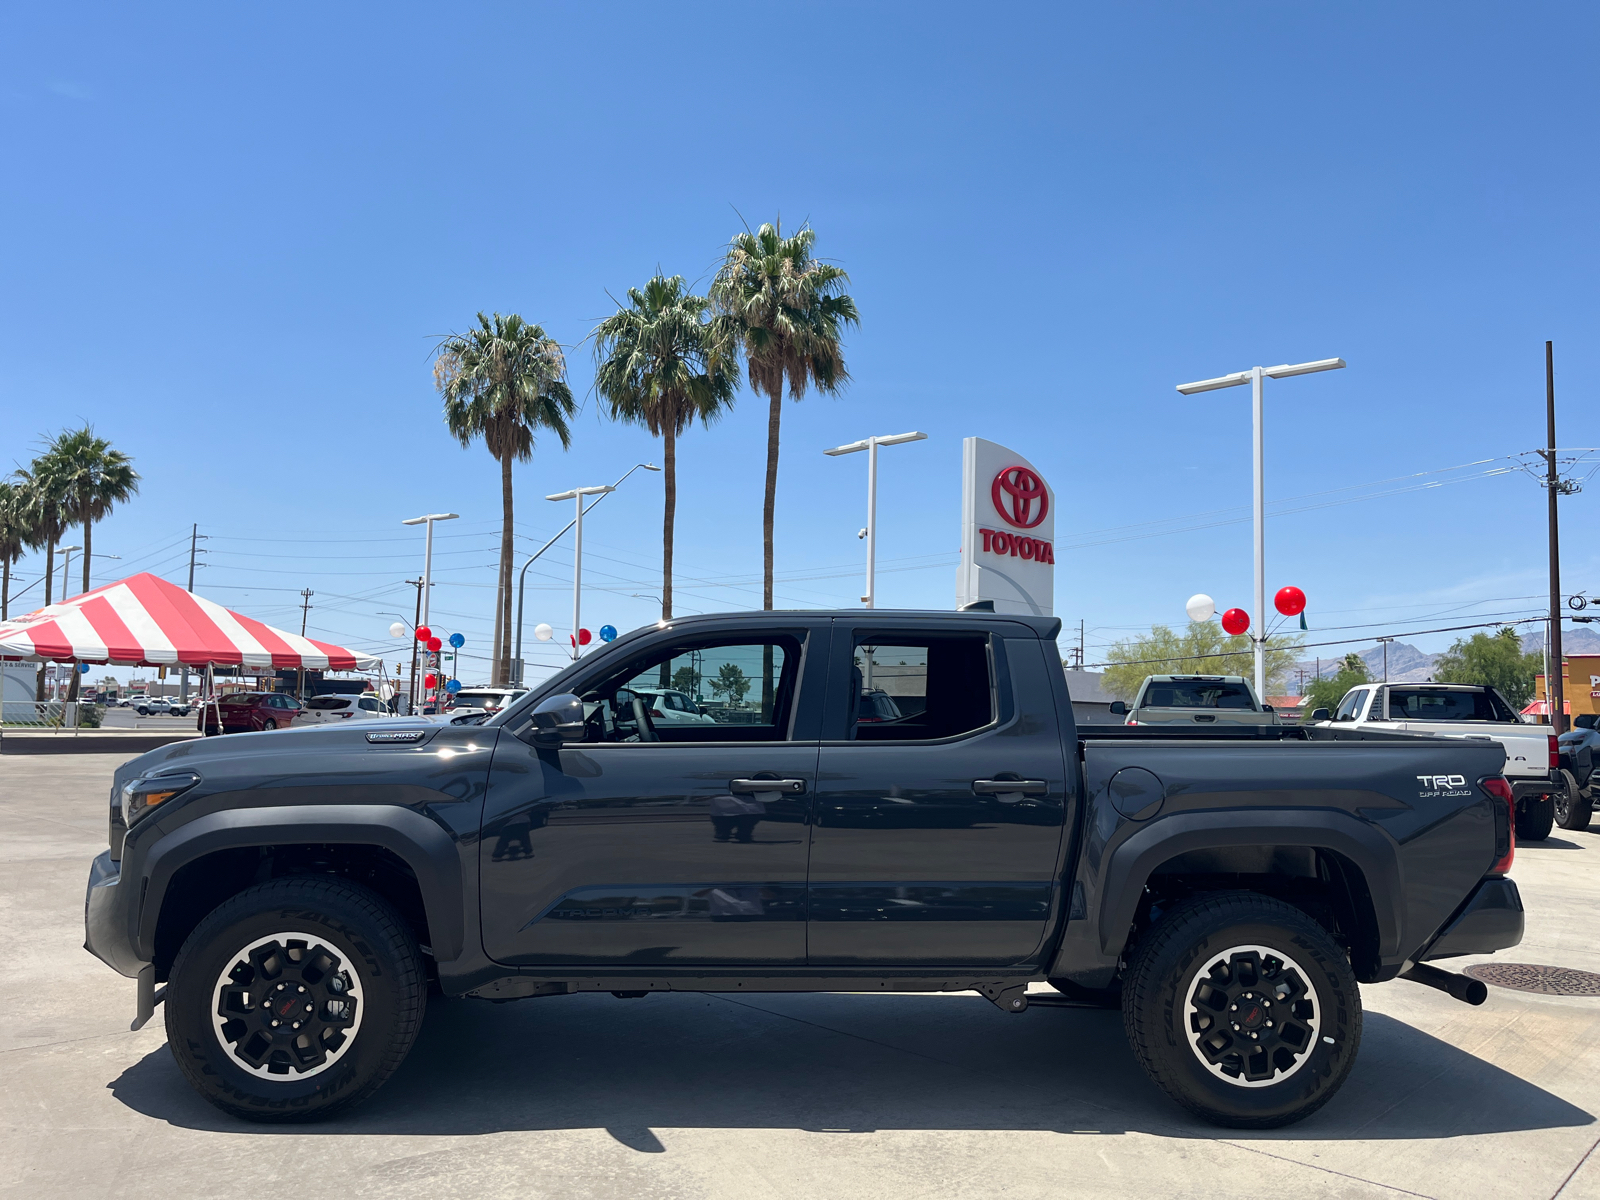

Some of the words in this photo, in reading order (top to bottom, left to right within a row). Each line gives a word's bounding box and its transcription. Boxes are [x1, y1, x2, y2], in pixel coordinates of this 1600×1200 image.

[979, 528, 1055, 565] TOYOTA
[1416, 774, 1466, 790] TRD
[553, 907, 652, 917] TACOMA
[280, 909, 383, 977] FALKEN
[1163, 937, 1210, 1047] FALKEN
[216, 1067, 357, 1109] WILDPEAK
